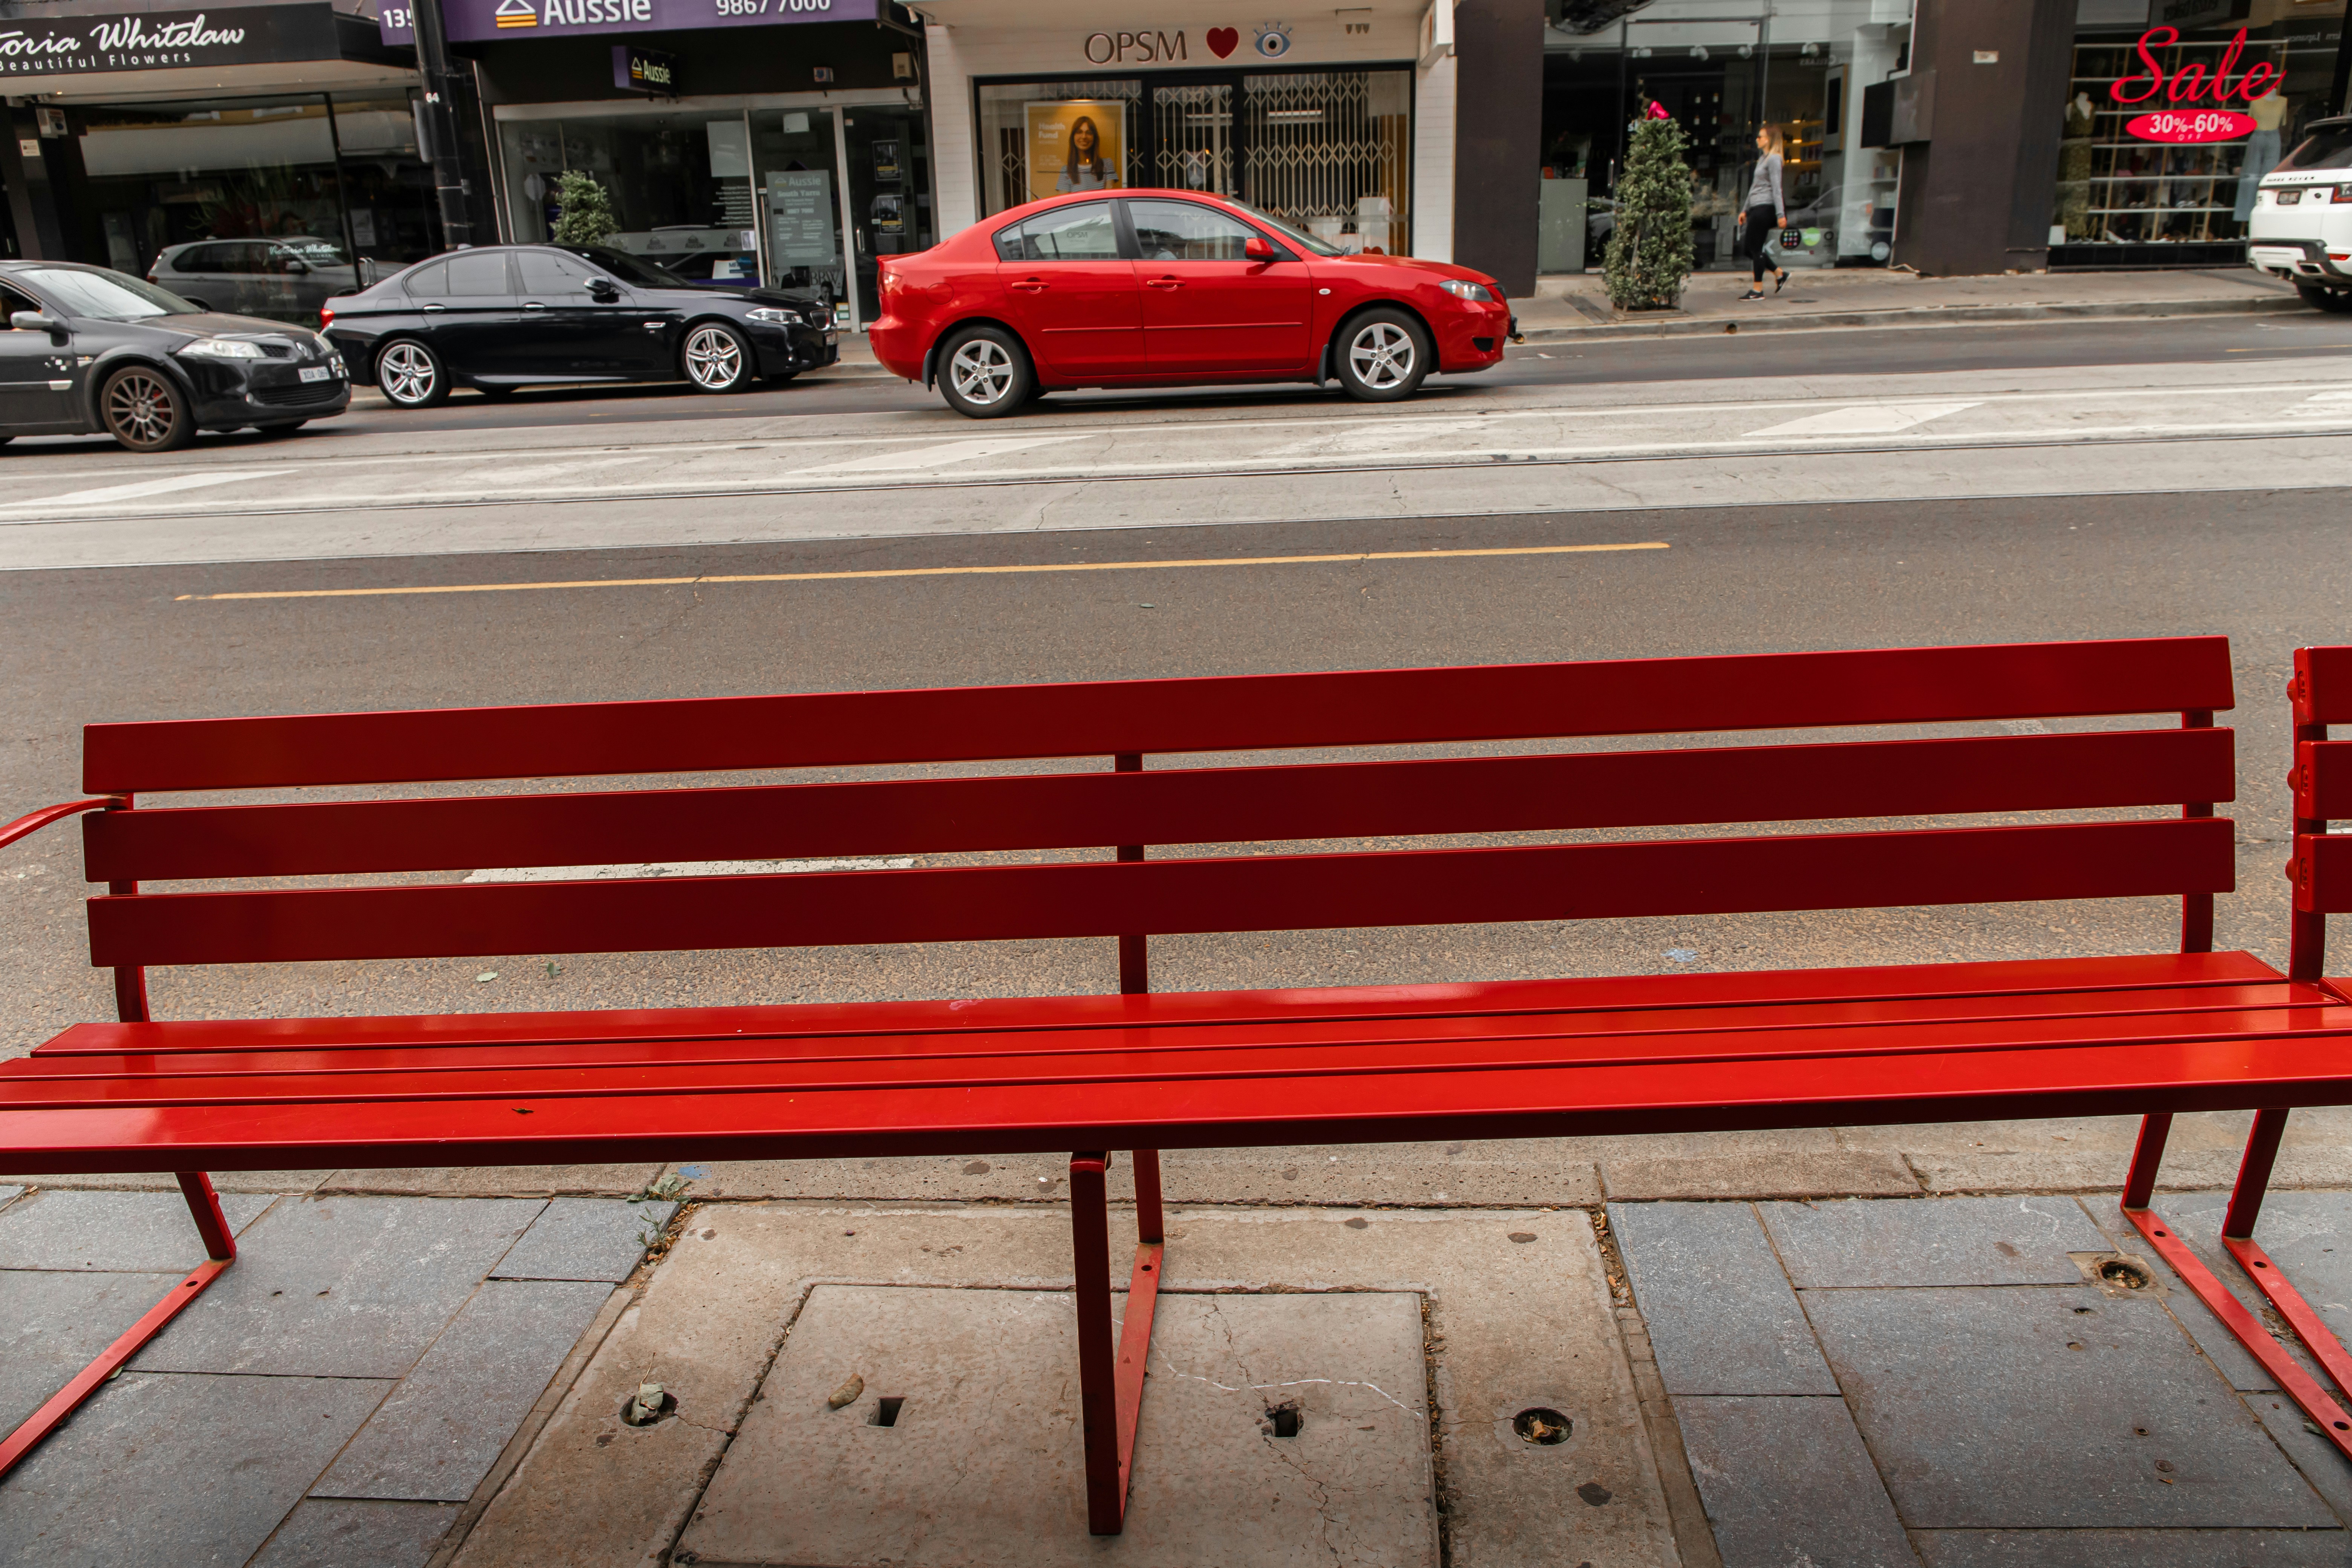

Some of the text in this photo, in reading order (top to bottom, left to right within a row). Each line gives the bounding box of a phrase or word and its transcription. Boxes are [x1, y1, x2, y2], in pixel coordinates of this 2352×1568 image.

[544, 0, 652, 26] Aussie
[90, 14, 245, 51] Whitelaw
[1084, 30, 1187, 64] OPSM
[0, 52, 191, 71] Beautiful Flowers
[643, 59, 671, 84] Aussie
[2110, 26, 2287, 103] Sale
[426, 92, 440, 103] 64
[2149, 113, 2233, 133] 30%-60%
[789, 176, 821, 187] Aussie
